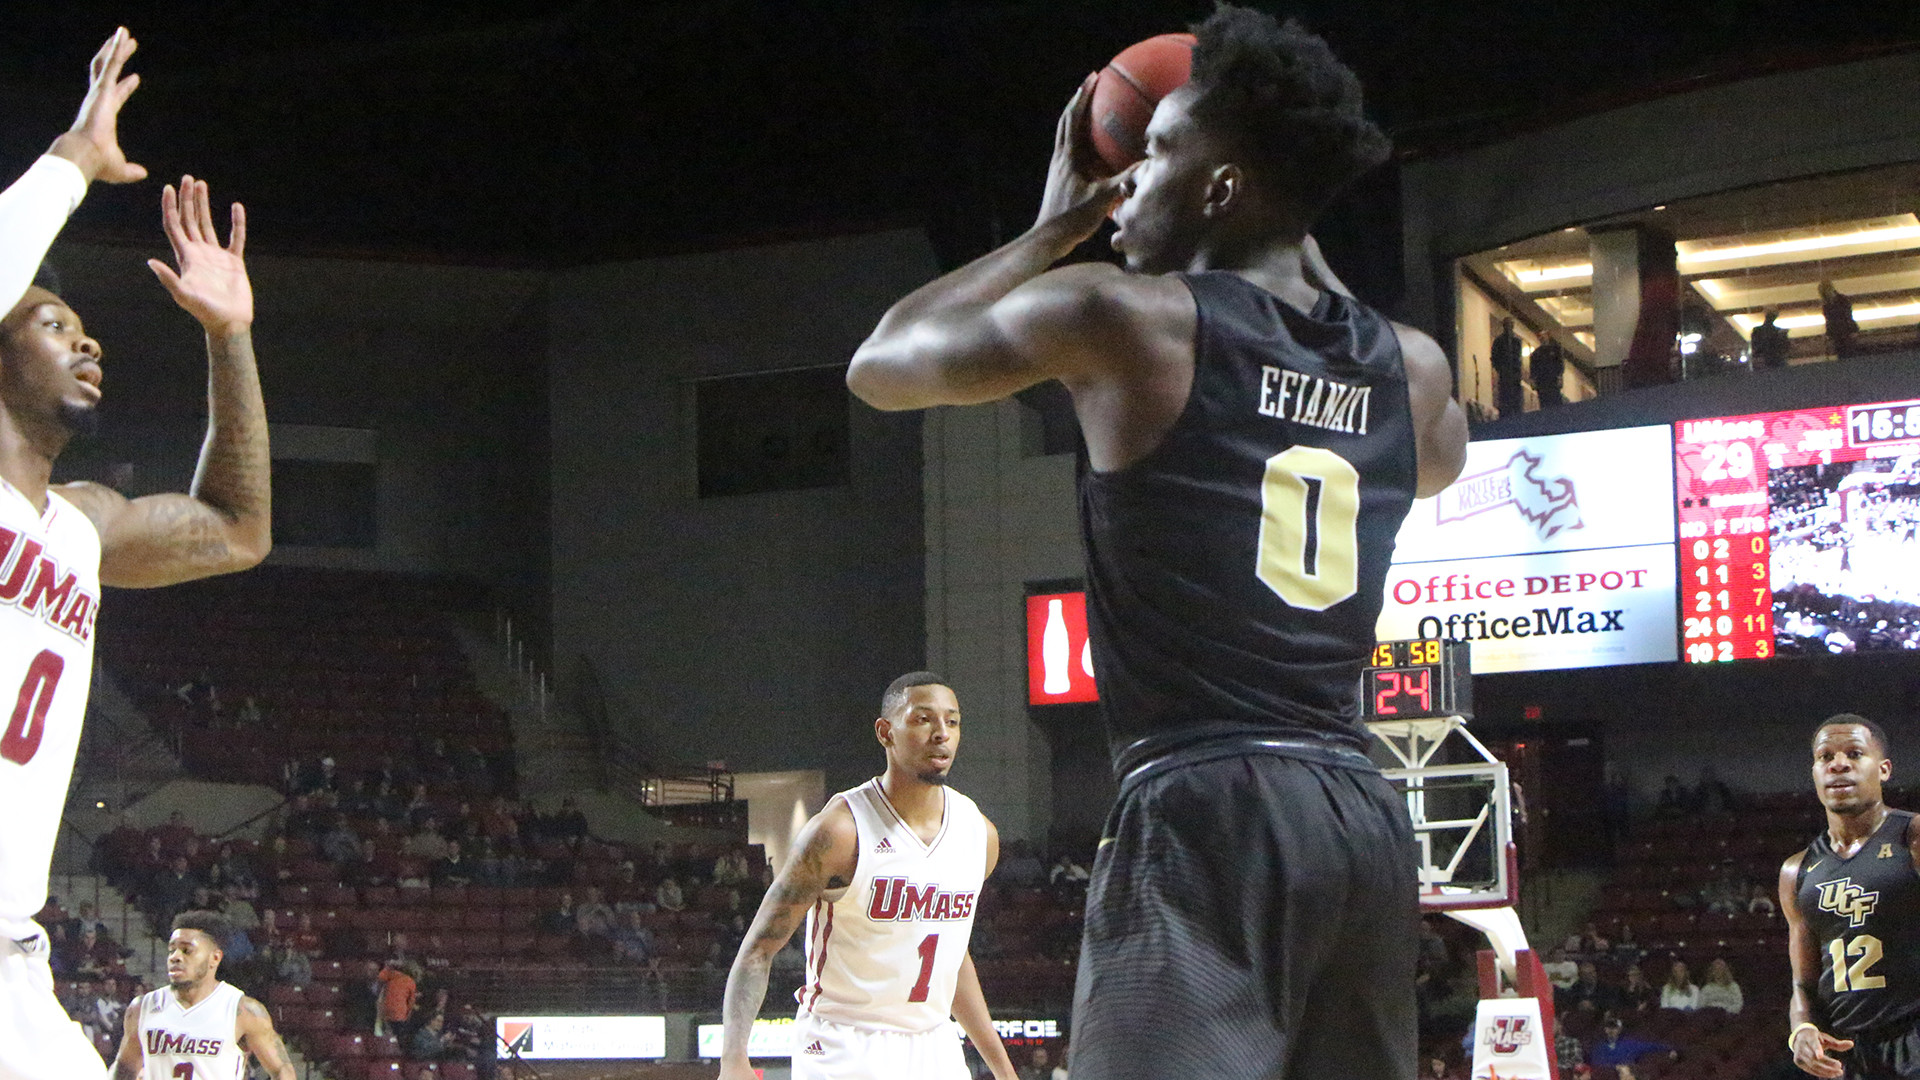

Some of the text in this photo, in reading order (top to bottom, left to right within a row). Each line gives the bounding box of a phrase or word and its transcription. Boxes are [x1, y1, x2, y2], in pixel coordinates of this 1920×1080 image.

[1701, 441, 1753, 480] 29
[1256, 444, 1360, 612] 0
[1714, 519, 1727, 535] F
[1693, 536, 1765, 560] 0 2 0
[1393, 569, 1648, 605] Office DEPOT
[1695, 563, 1766, 585] 1 1 3
[1695, 588, 1766, 612] 2 1 7
[1418, 606, 1625, 642] OfficeMax
[1684, 614, 1766, 638] 24 0 11
[1687, 640, 1769, 664] 10 2 3
[0, 648, 65, 767] 0
[1376, 670, 1430, 714] 24
[1815, 877, 1880, 928] UCF
[907, 933, 940, 1003] 1
[1828, 934, 1887, 993] 12
[145, 1028, 223, 1056] UMASS
